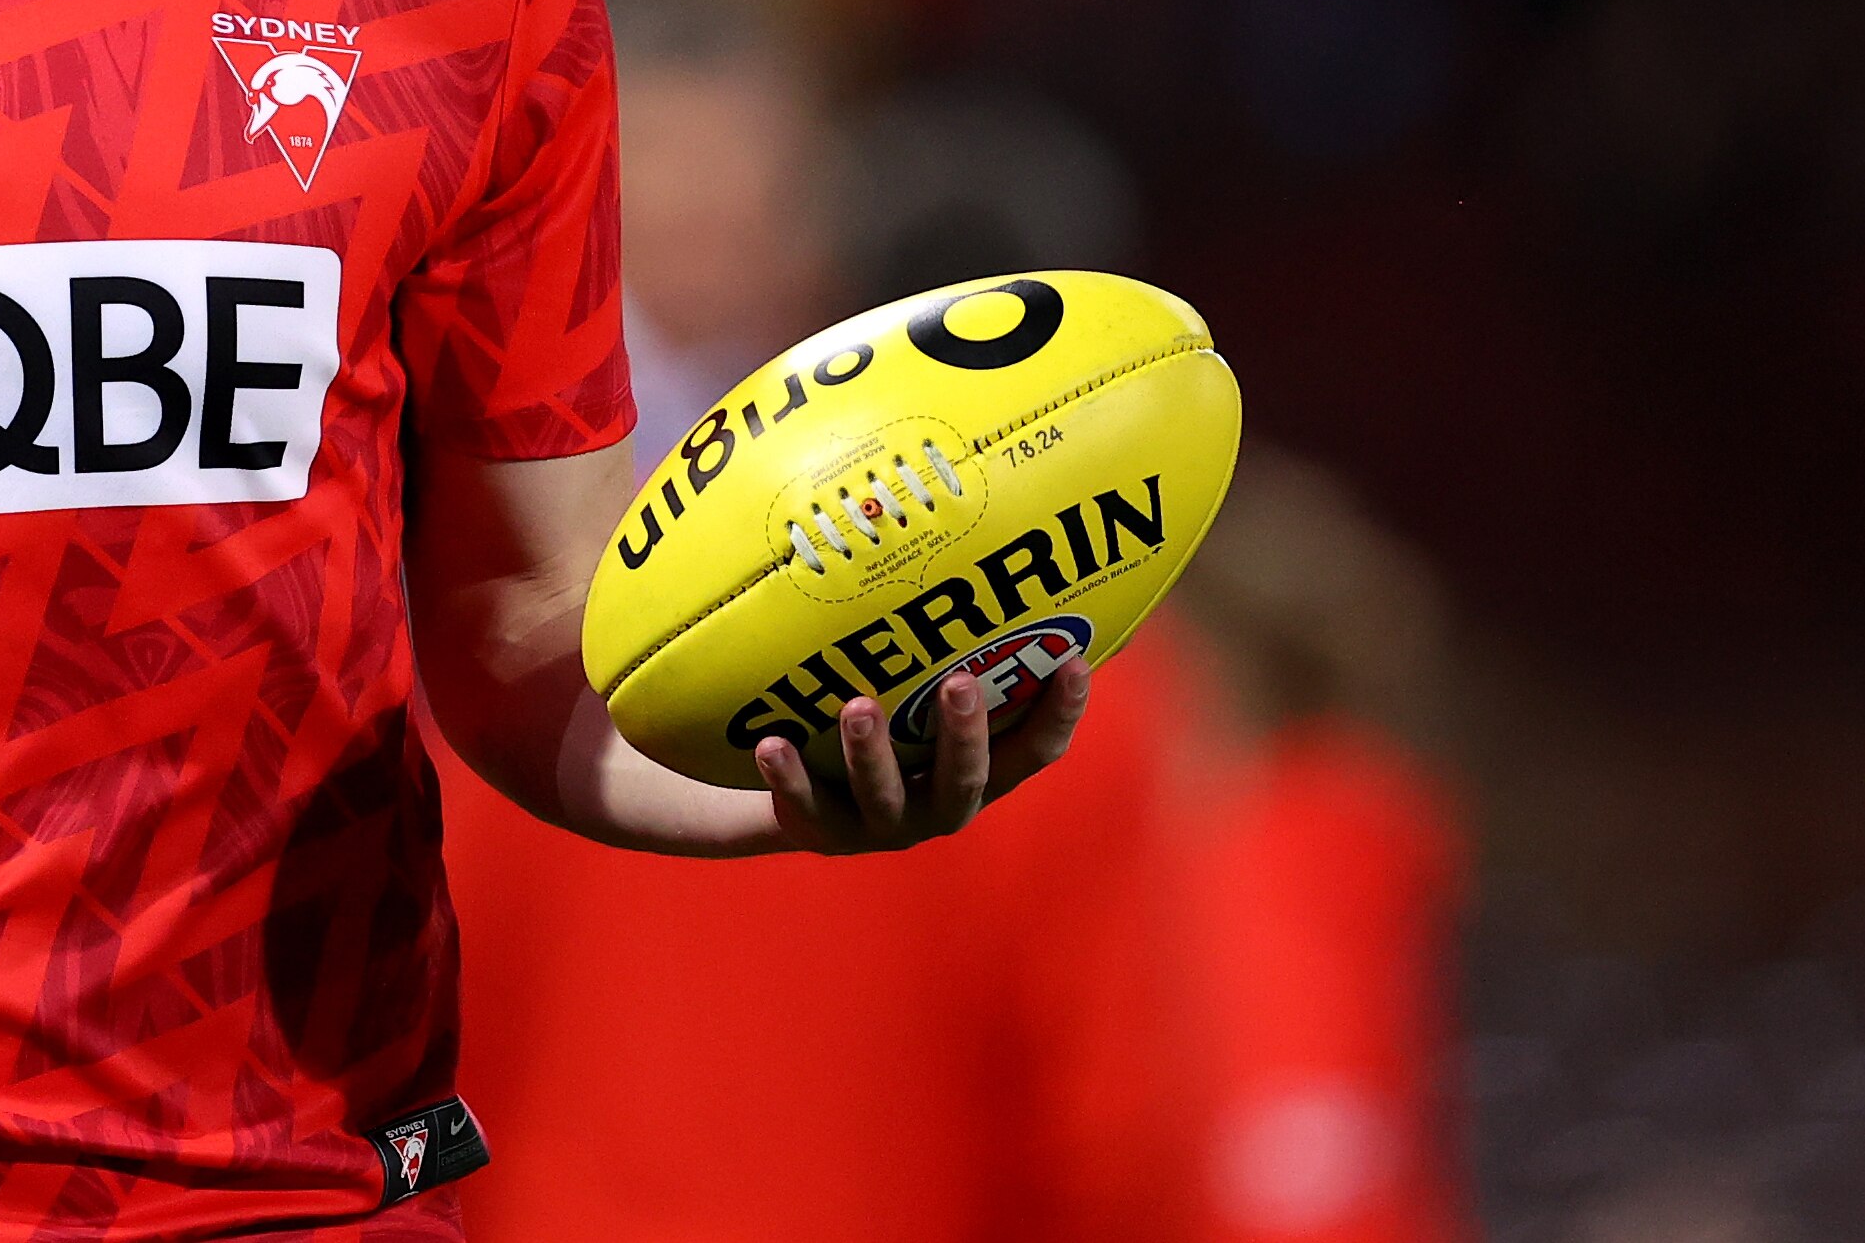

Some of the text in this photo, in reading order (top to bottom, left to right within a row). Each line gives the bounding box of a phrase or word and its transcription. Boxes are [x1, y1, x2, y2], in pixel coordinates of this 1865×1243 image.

[211, 13, 361, 46] SYDNEY
[288, 135, 313, 149] 1874
[618, 343, 875, 570] origin
[1001, 424, 1064, 468] 7.8.24
[858, 569, 888, 588] GRASS
[886, 548, 924, 574] SURFACE
[865, 550, 898, 573] INFLATE
[898, 543, 910, 555] TO
[1054, 558, 1142, 609] KANGAROO BRAND
[725, 473, 1166, 752] SHERRIN
[386, 1118, 426, 1140] SYDNEY
